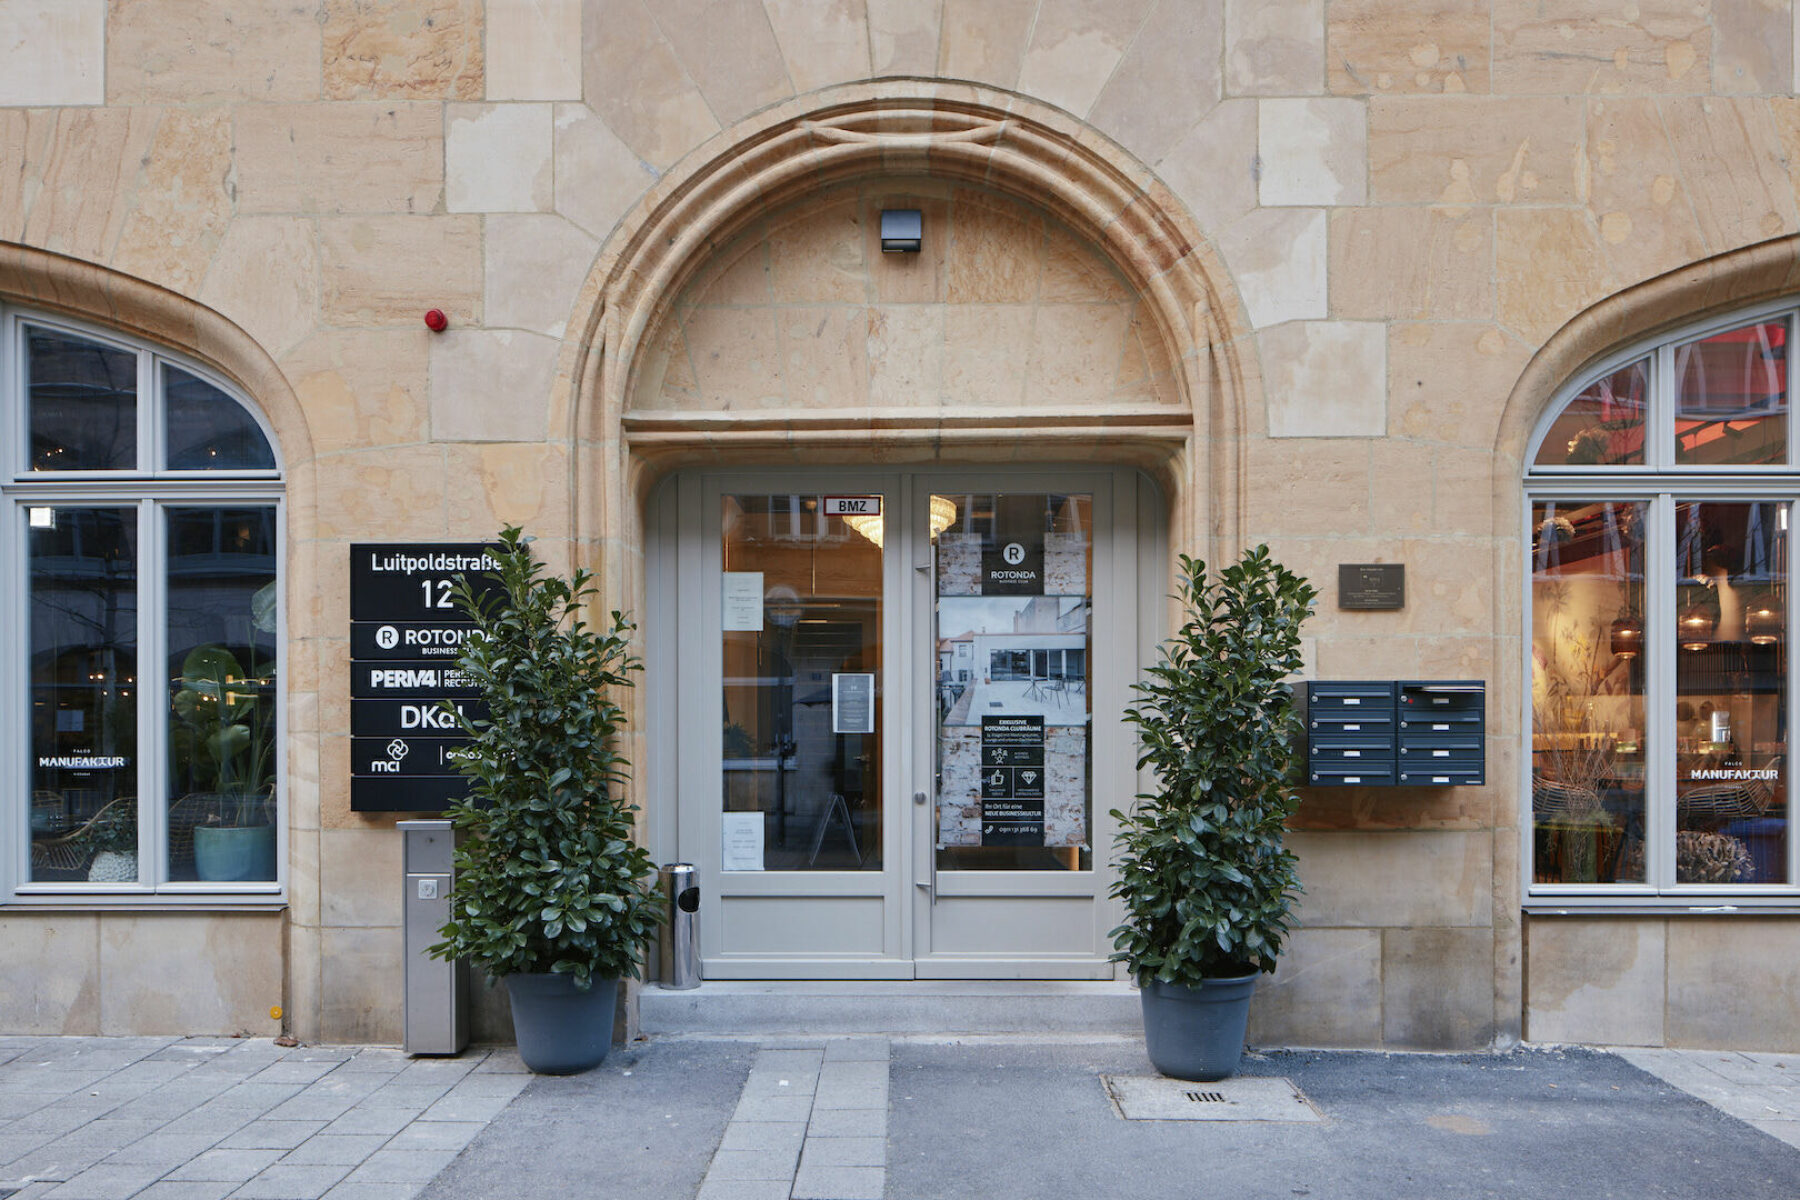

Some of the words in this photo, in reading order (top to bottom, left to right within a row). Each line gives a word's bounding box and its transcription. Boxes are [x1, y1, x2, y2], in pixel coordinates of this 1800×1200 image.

[839, 501, 867, 512] BMZ
[371, 553, 502, 575] Luitpoldstraße
[991, 571, 1036, 579] ROTONDA
[421, 579, 454, 609] 12
[421, 647, 458, 655] BUSINESS
[39, 757, 124, 767] MANUFAKTUR
[371, 760, 400, 772] mci
[1691, 769, 1779, 780] MANUFAKTUR
